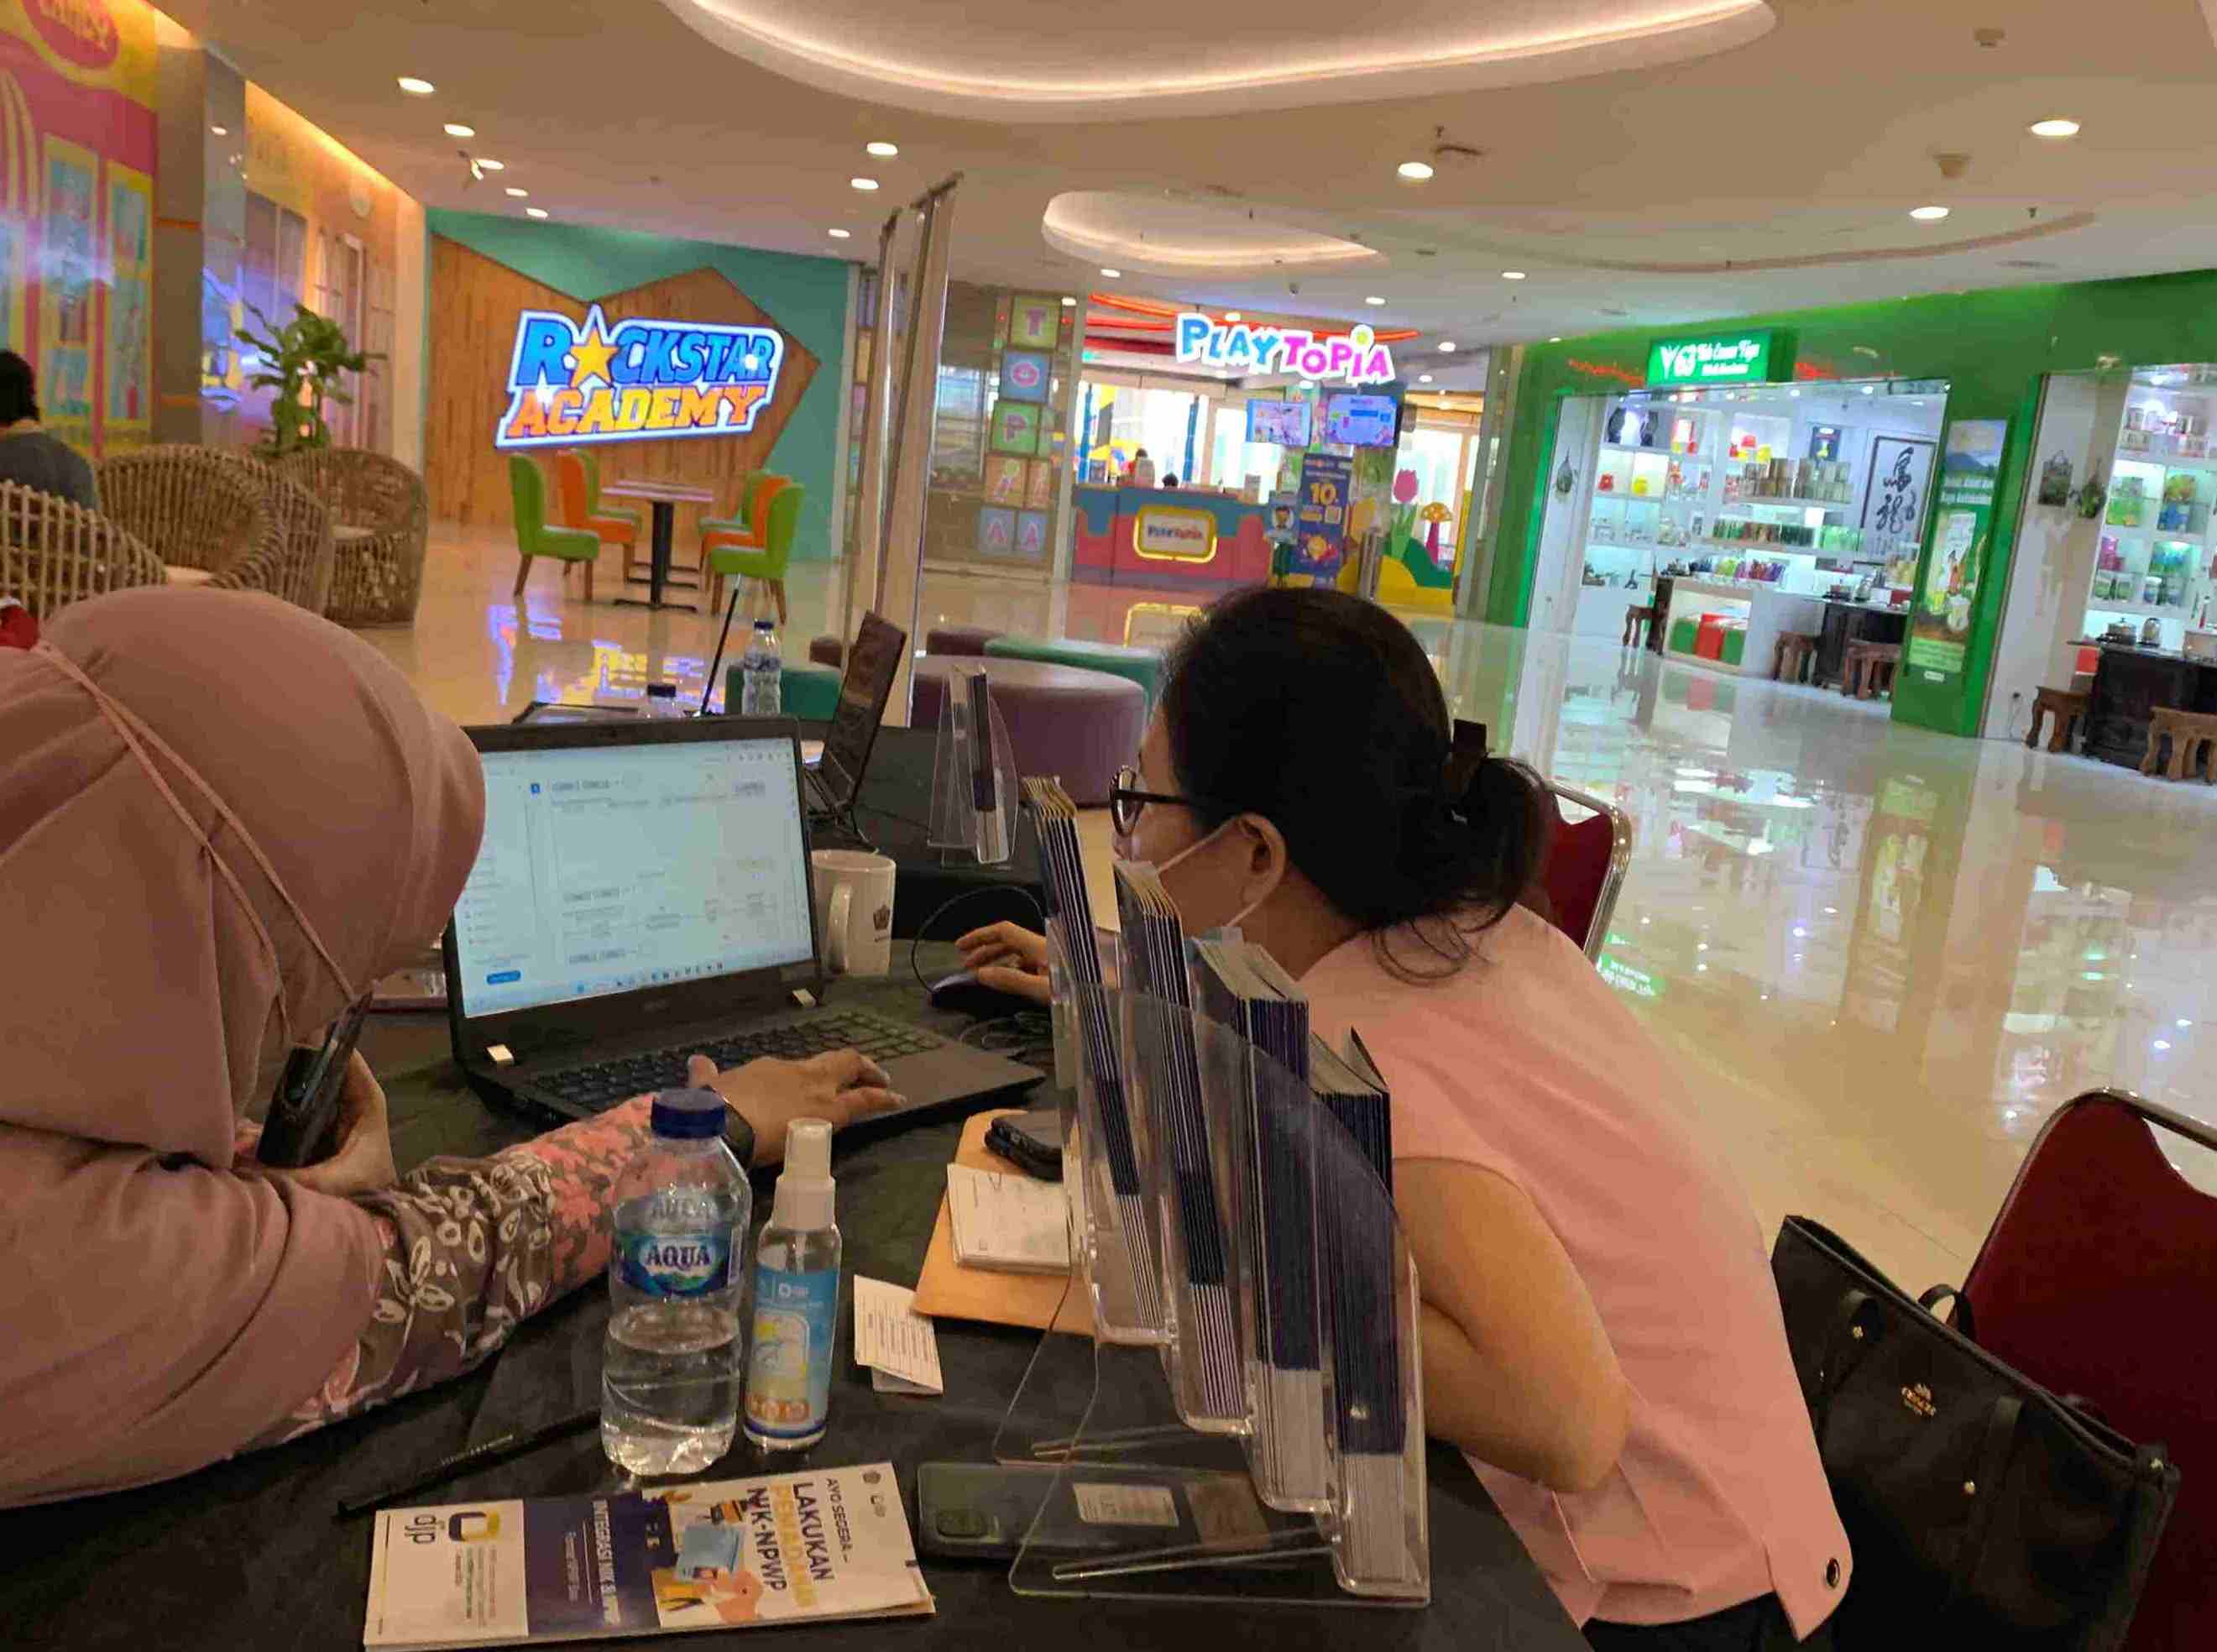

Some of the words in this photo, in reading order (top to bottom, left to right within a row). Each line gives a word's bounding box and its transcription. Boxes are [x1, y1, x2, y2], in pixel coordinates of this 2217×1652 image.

[1179, 315, 1393, 383] PLAYTOPIA
[505, 384, 766, 438] ACADEMY
[645, 1244, 712, 1271] AQUA
[826, 1478, 842, 1502] AYO
[404, 1513, 445, 1545] djp
[746, 1487, 787, 1591] NIK-NPWP
[792, 1482, 835, 1581] LAKUKAN
